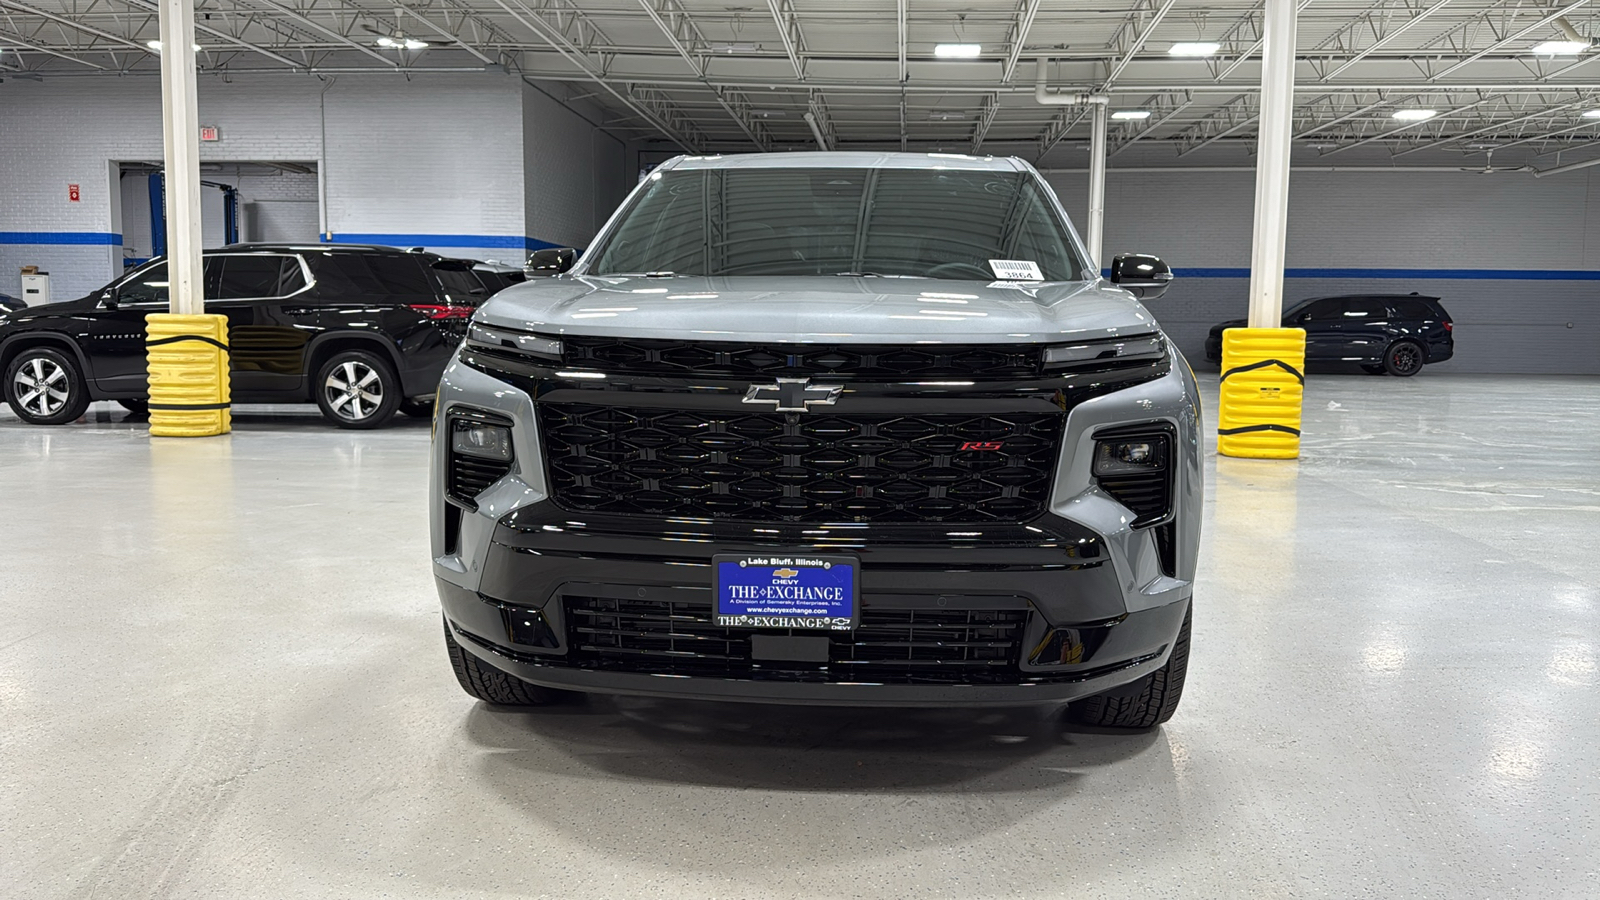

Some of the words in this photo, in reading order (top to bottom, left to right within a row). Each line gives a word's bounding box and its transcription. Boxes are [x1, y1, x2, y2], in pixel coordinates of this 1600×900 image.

[203, 129, 215, 139] EXIT
[1004, 271, 1034, 279] 3864
[960, 441, 1004, 451] RS
[747, 557, 769, 565] Lake
[770, 557, 794, 566] Bluff,
[795, 558, 824, 566] Illinois
[728, 585, 759, 599] THE
[766, 586, 843, 600] EXCHANGE
[746, 607, 828, 615] www.chevyexchange.com
[717, 616, 742, 626] THE
[753, 617, 824, 628] EXCHANGE
